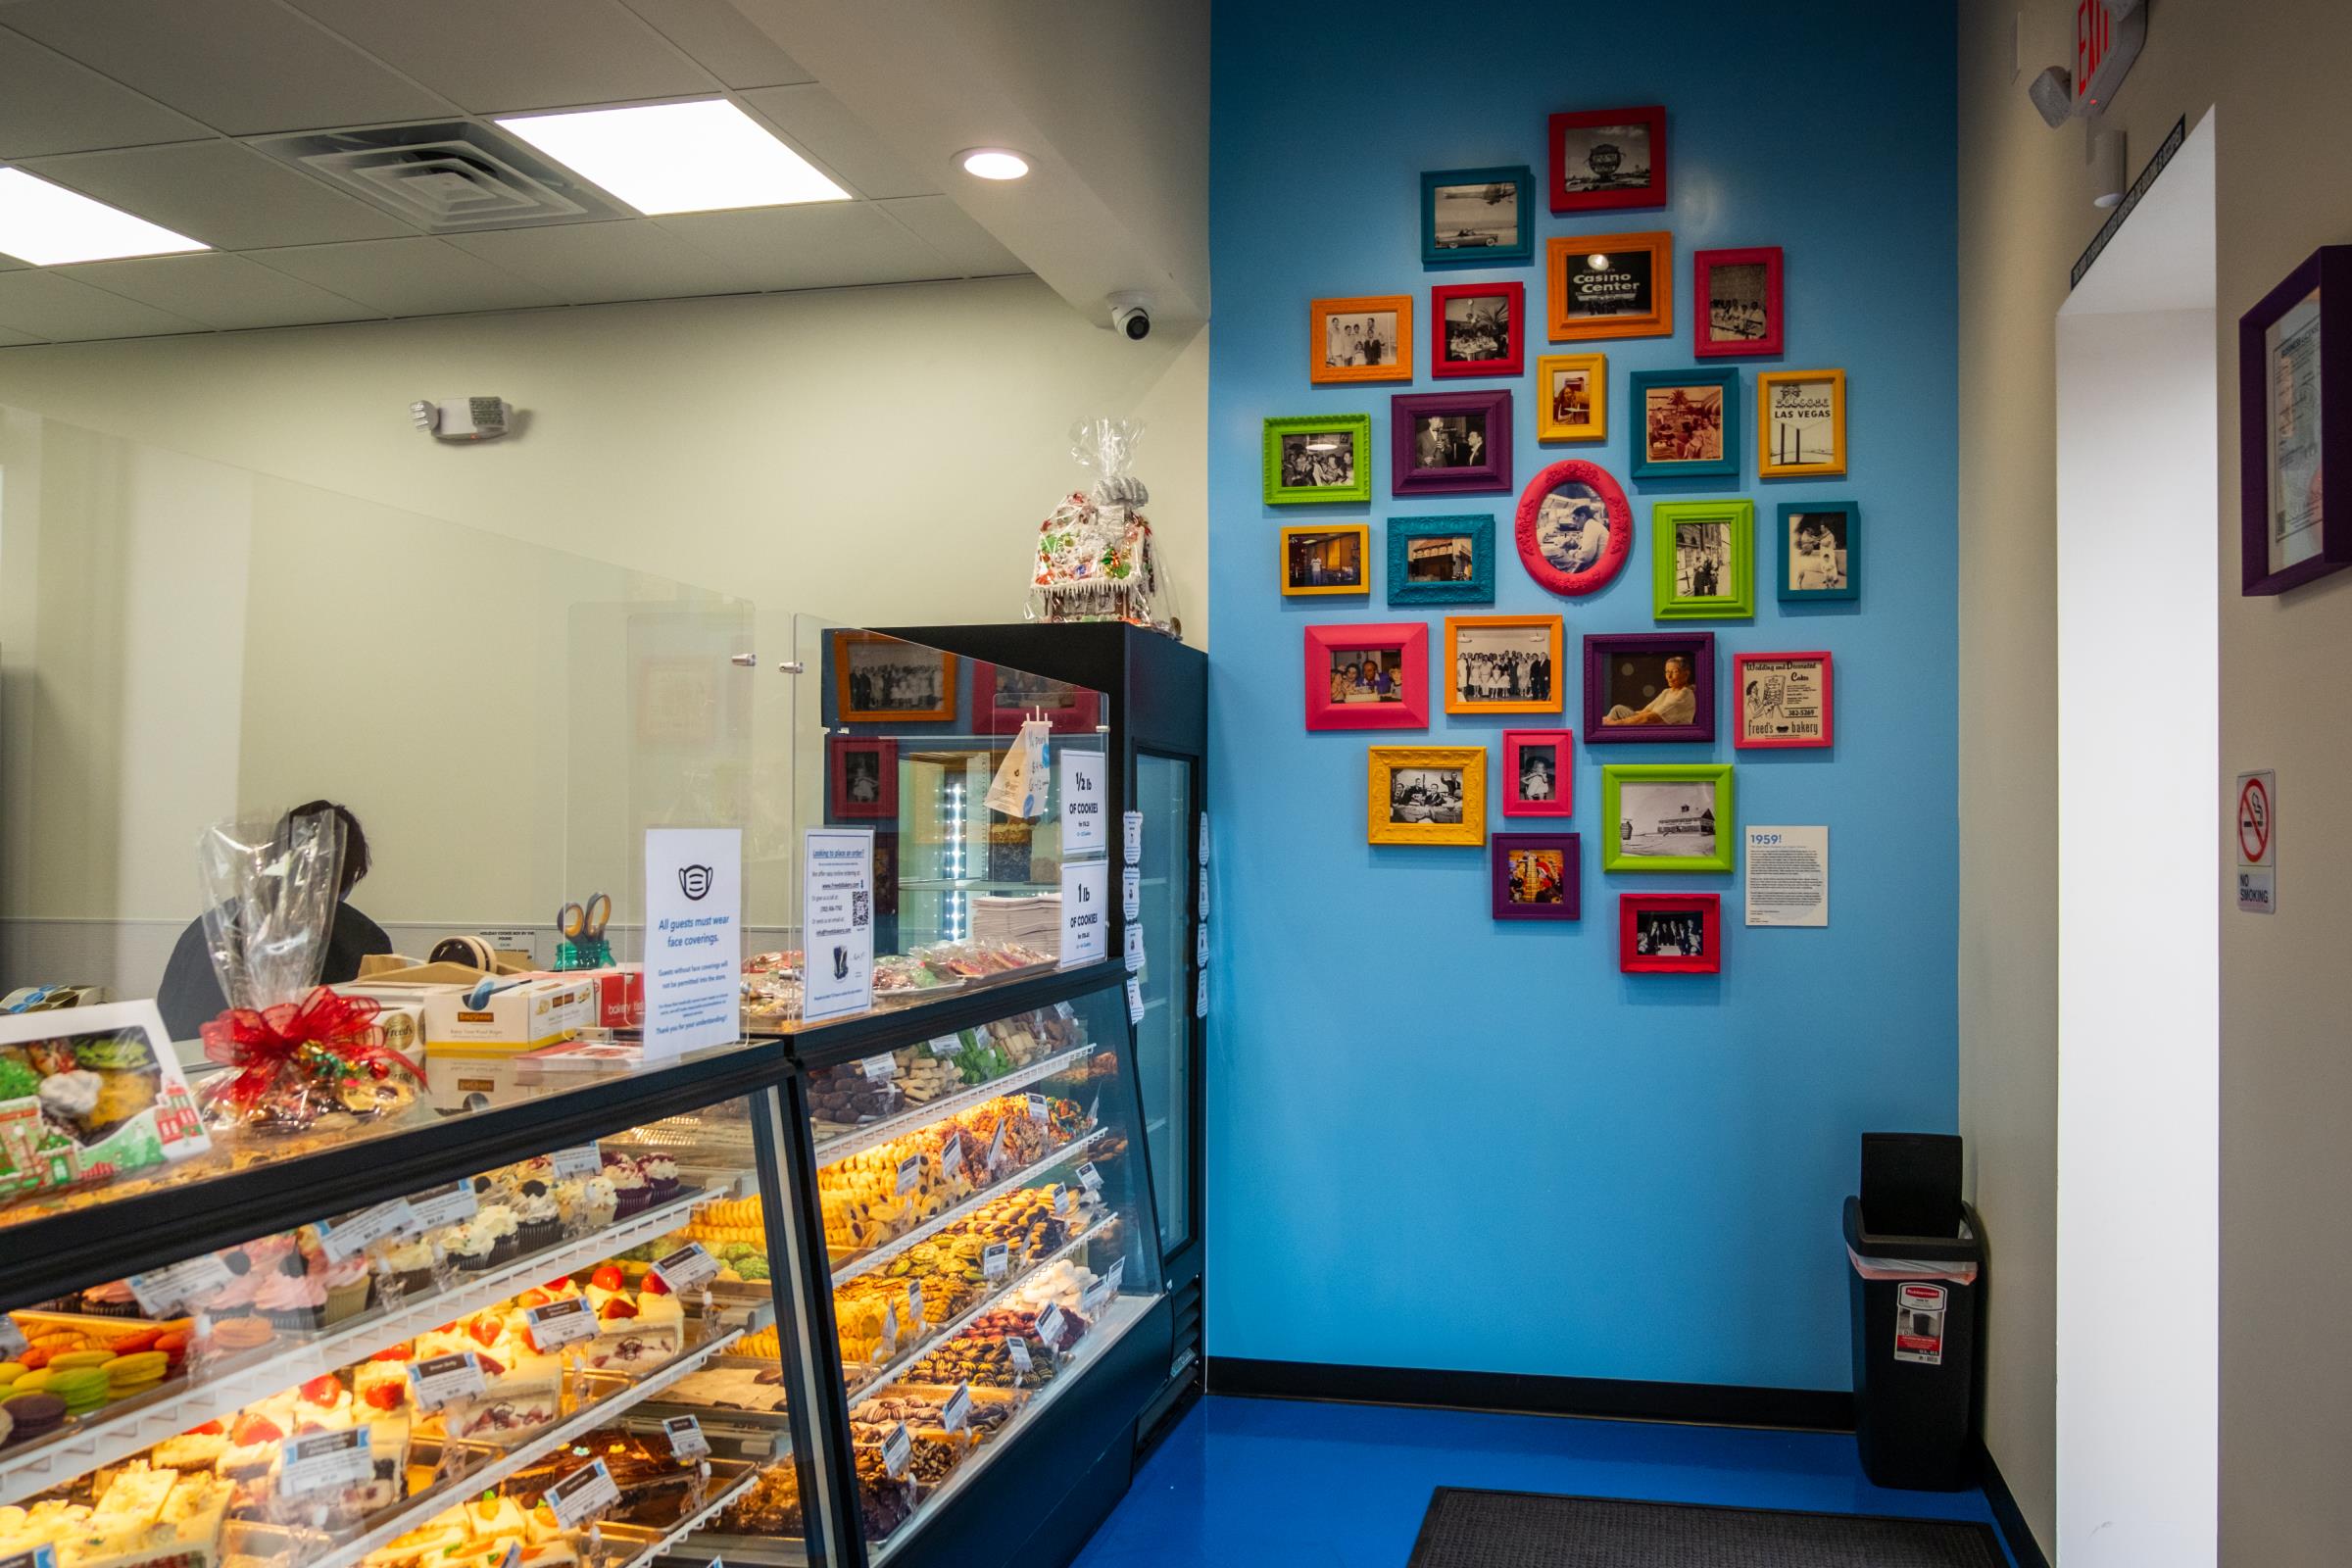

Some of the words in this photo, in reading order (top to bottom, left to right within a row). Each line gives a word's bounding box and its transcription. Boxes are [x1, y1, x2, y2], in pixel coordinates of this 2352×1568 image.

[1573, 273, 1631, 284] Casino
[1582, 281, 1641, 293] Center
[1797, 410, 1831, 418] VEGAS
[1746, 662, 1775, 672] Wedding
[1787, 661, 1817, 670] Decorated
[1790, 671, 1809, 682] Cakes
[1748, 719, 1774, 737] freed's
[1791, 721, 1818, 736] bakery
[1086, 778, 1093, 791] lb
[1069, 803, 1077, 814] OF
[1077, 802, 1099, 814] COOKIES
[1750, 834, 1782, 845] 1959!
[813, 850, 829, 858] Looking
[834, 850, 845, 858] place
[2240, 874, 2249, 887] NO
[1078, 883, 1082, 903] 1
[1083, 887, 1090, 903] lb
[2240, 888, 2268, 904] SMOKING
[659, 918, 668, 930] All
[670, 918, 694, 932] guests
[695, 917, 711, 927] must
[713, 915, 730, 925] wear
[1070, 916, 1077, 928] OF
[1077, 912, 1098, 926] COOKIES
[667, 936, 683, 948] face
[684, 933, 719, 947] coverings.
[702, 962, 720, 971] coverings
[677, 978, 699, 988] permitted
[608, 1003, 631, 1015] bakery
[656, 1026, 669, 1035] Thank
[685, 1022, 695, 1031] your
